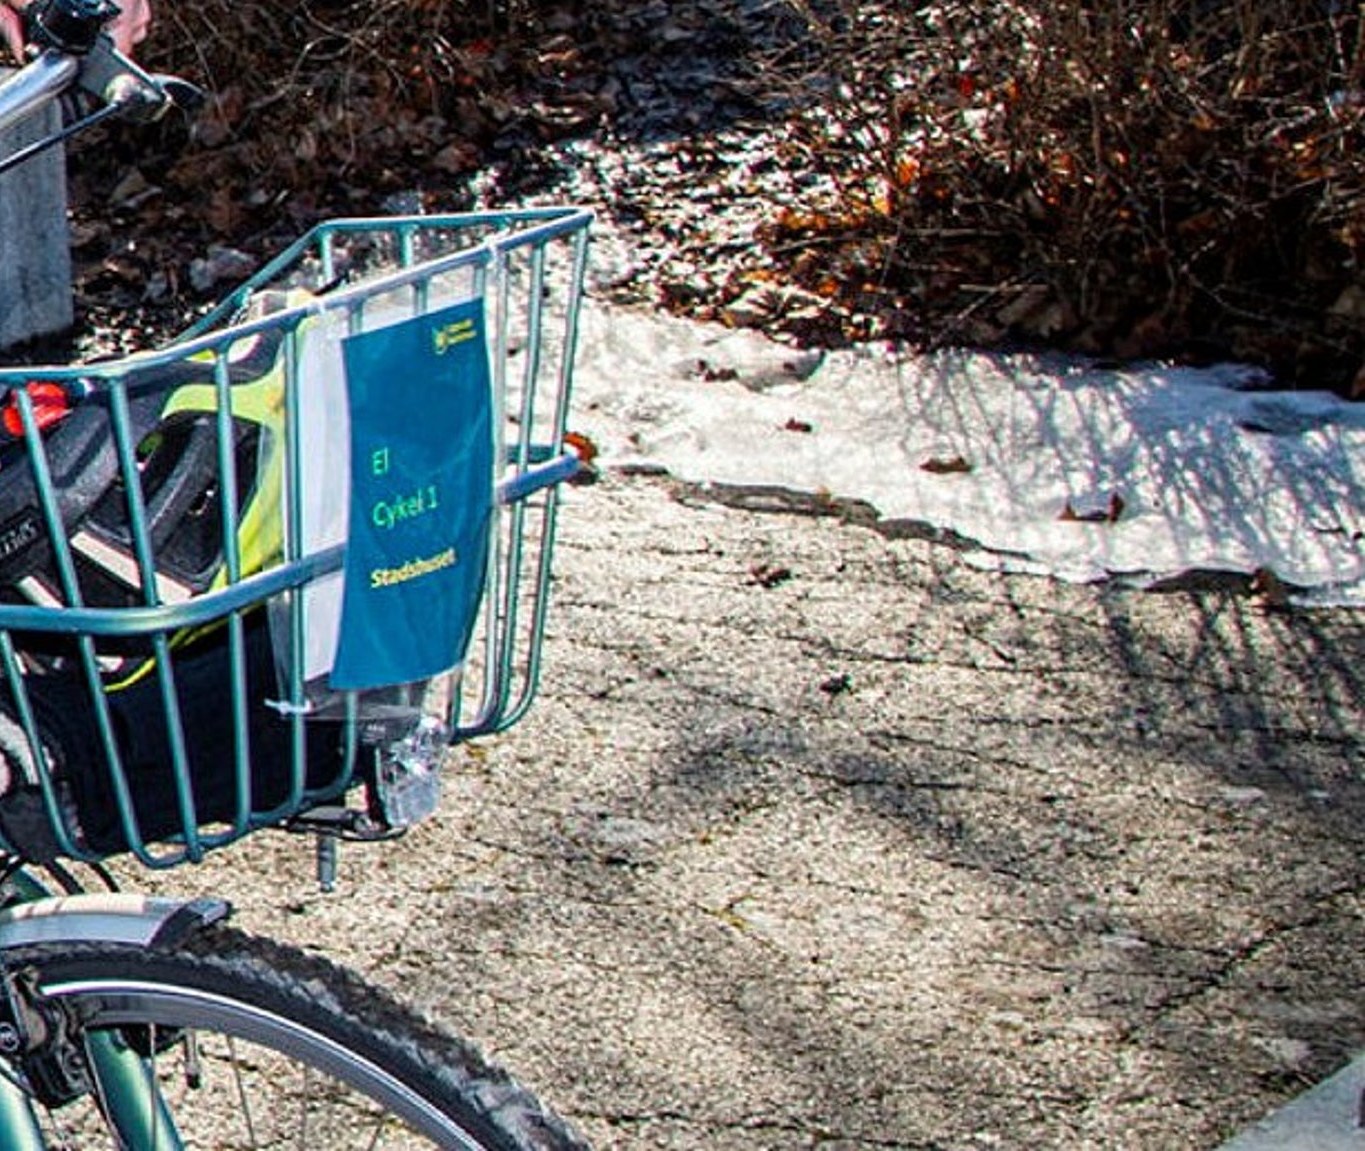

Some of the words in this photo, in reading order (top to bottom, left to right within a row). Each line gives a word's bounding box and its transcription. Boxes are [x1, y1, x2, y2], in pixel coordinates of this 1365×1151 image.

[372, 447, 388, 475] El
[373, 489, 425, 529] Cykel
[427, 485, 437, 508] 1
